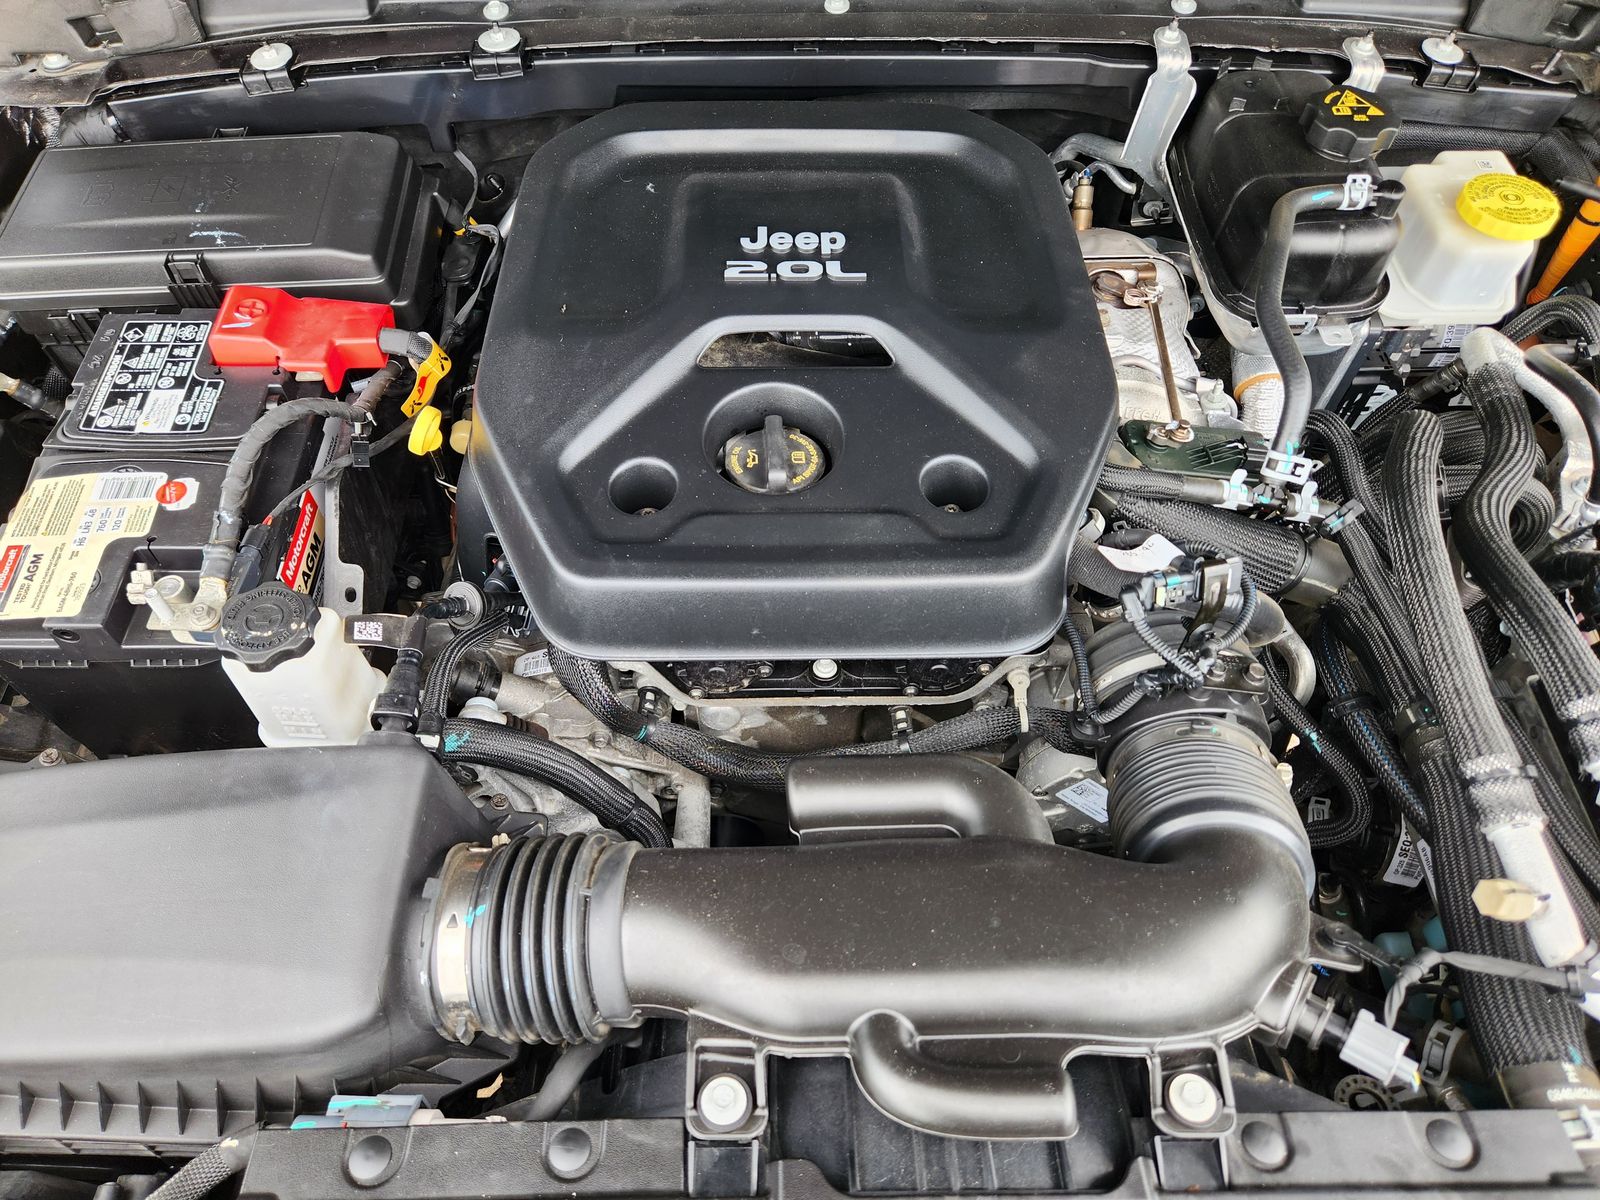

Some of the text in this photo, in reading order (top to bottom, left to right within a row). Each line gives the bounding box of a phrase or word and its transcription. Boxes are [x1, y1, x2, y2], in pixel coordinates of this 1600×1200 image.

[739, 225, 846, 258] Jeep
[724, 260, 868, 282] 2.0L
[96, 519, 108, 533] 760
[285, 502, 314, 581] Motorcraft
[24, 552, 45, 583] AGM
[301, 531, 322, 588] AGM
[13, 582, 26, 604] TESTED
